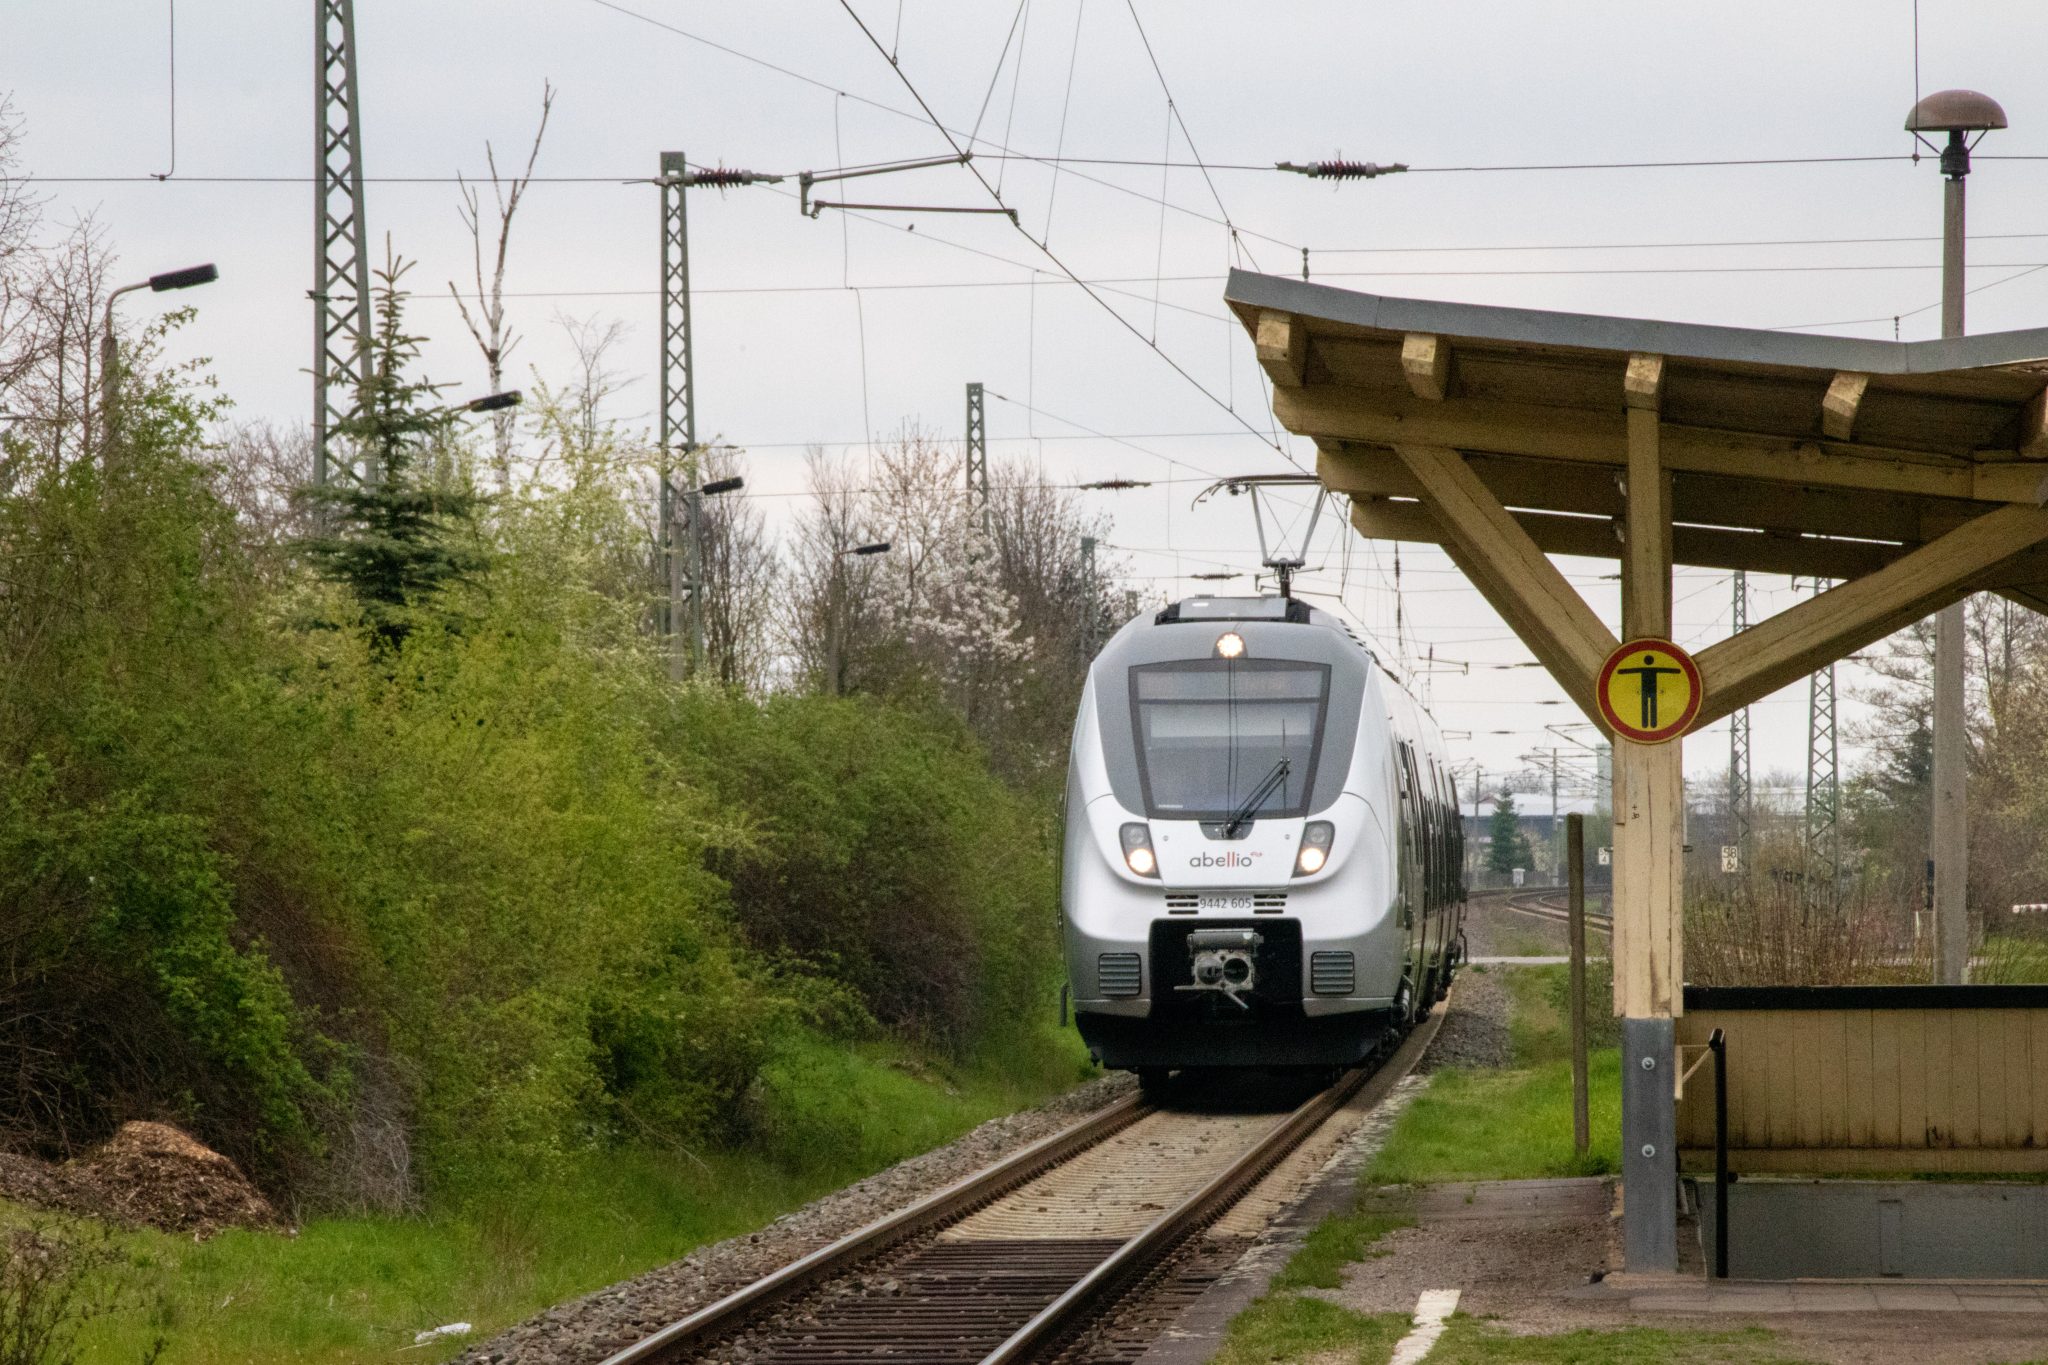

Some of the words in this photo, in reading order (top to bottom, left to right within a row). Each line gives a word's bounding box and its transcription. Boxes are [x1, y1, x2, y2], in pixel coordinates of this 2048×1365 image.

[1189, 851, 1253, 868] abellio
[1200, 898, 1227, 909] 9442
[1231, 898, 1252, 909] 605
